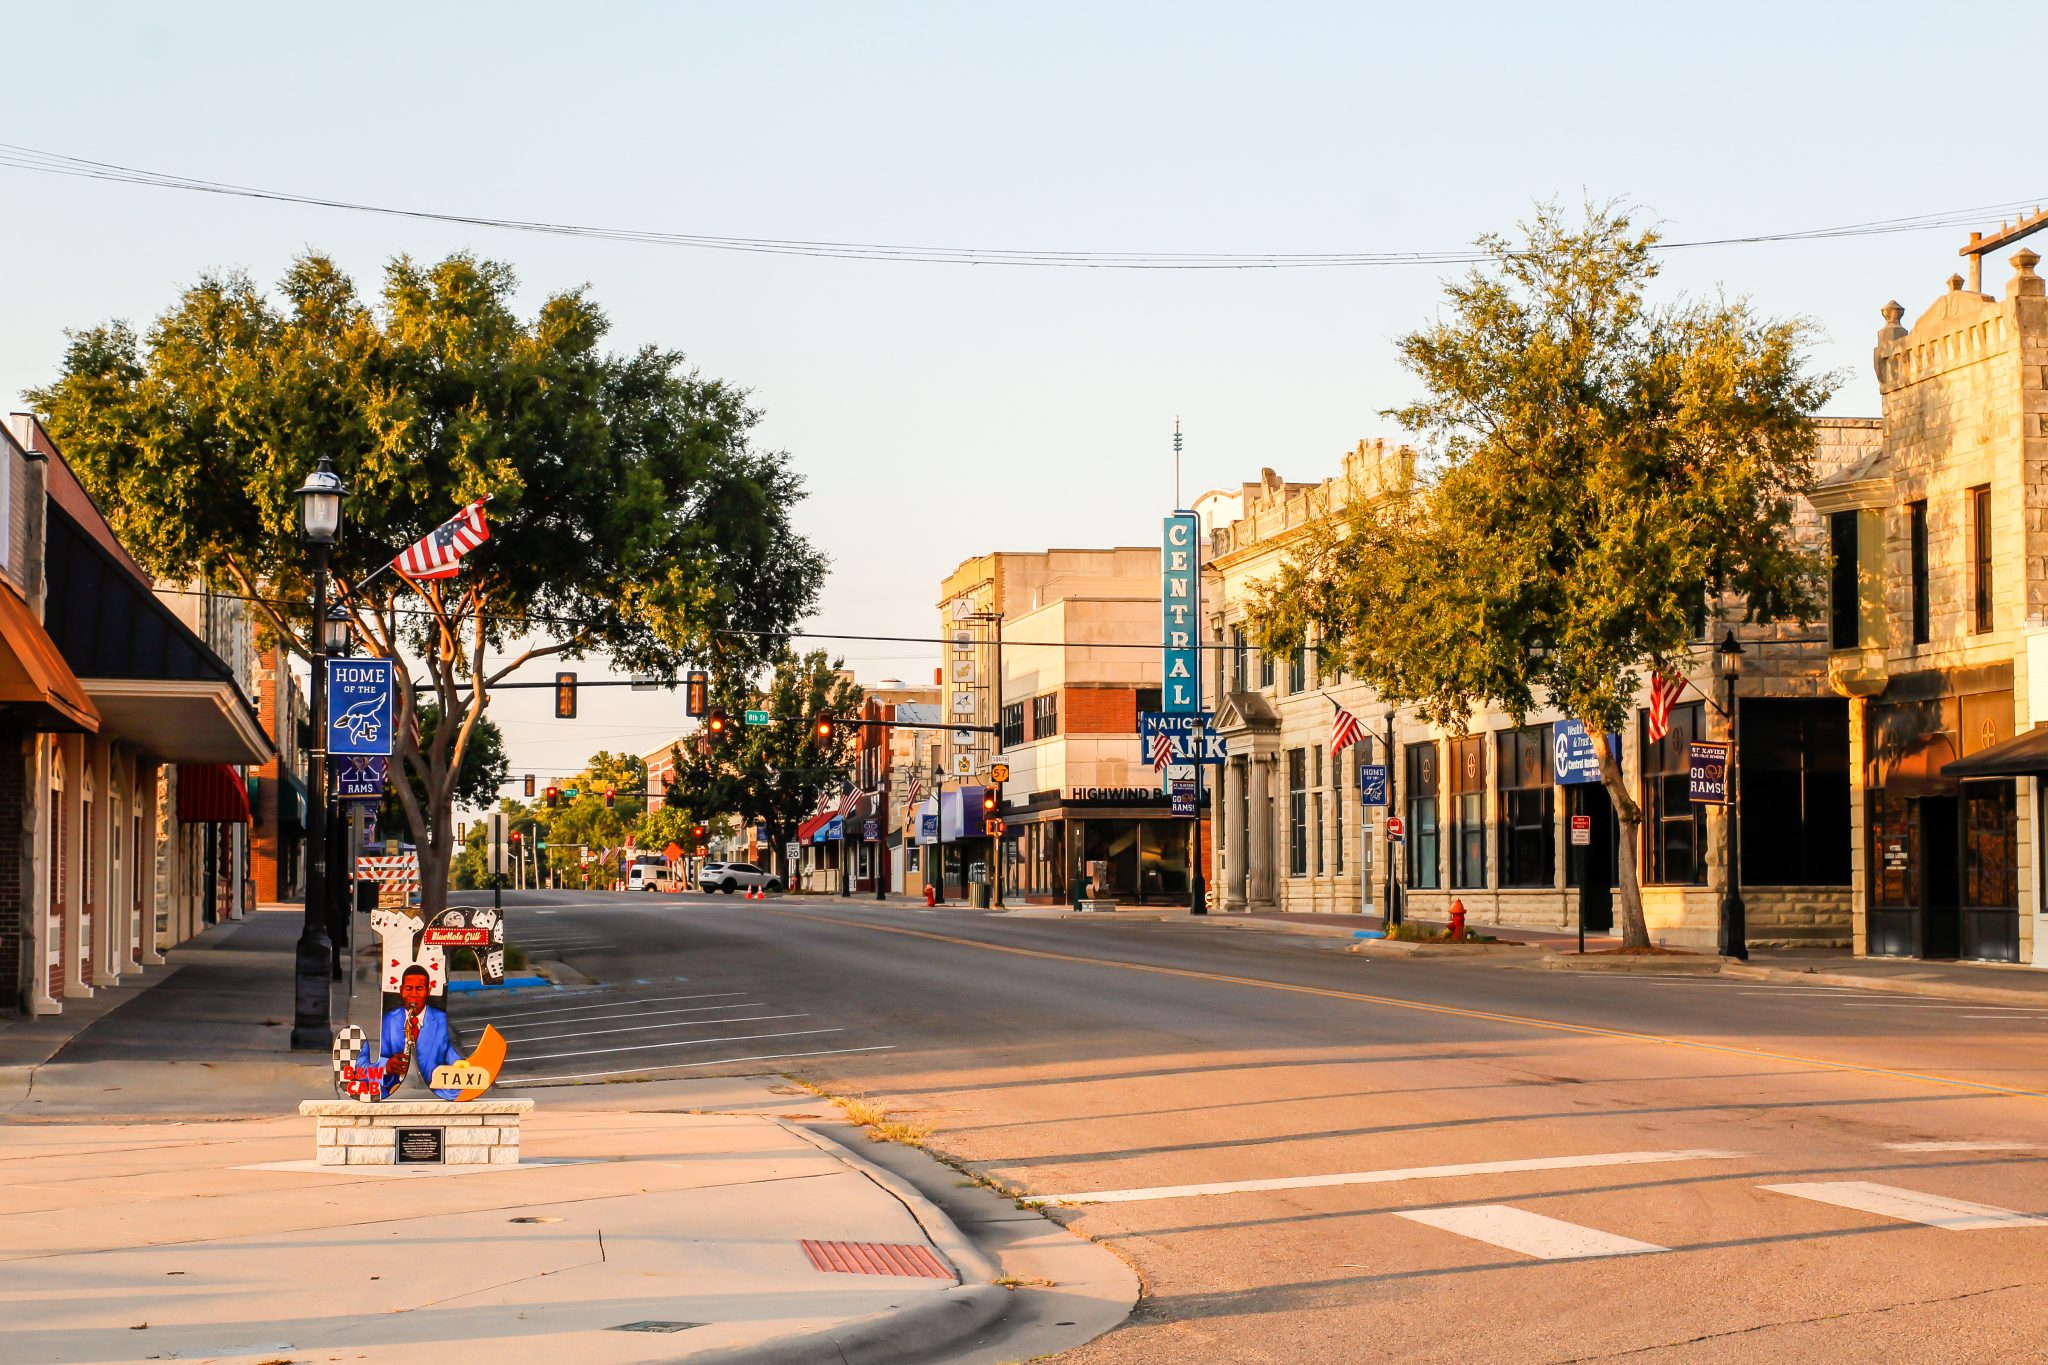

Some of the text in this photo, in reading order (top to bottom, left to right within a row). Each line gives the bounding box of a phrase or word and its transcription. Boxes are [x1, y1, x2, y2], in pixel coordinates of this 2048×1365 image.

[1168, 524, 1191, 705] CENTRAL
[335, 668, 385, 683] HOME
[993, 768, 1007, 778] 57
[1363, 768, 1384, 776] HOME
[1690, 767, 1705, 779] GO
[347, 784, 373, 793] RAMS
[1690, 780, 1724, 794] RAMS!
[1073, 788, 1149, 800] HIGHWIND
[1172, 795, 1182, 803] GO
[1172, 804, 1195, 812] RAMS!
[788, 850, 799, 858] 20
[465, 931, 483, 942] Grill
[343, 1066, 384, 1080] B&W
[441, 1072, 482, 1085] TAXI
[346, 1081, 381, 1095] CAB
